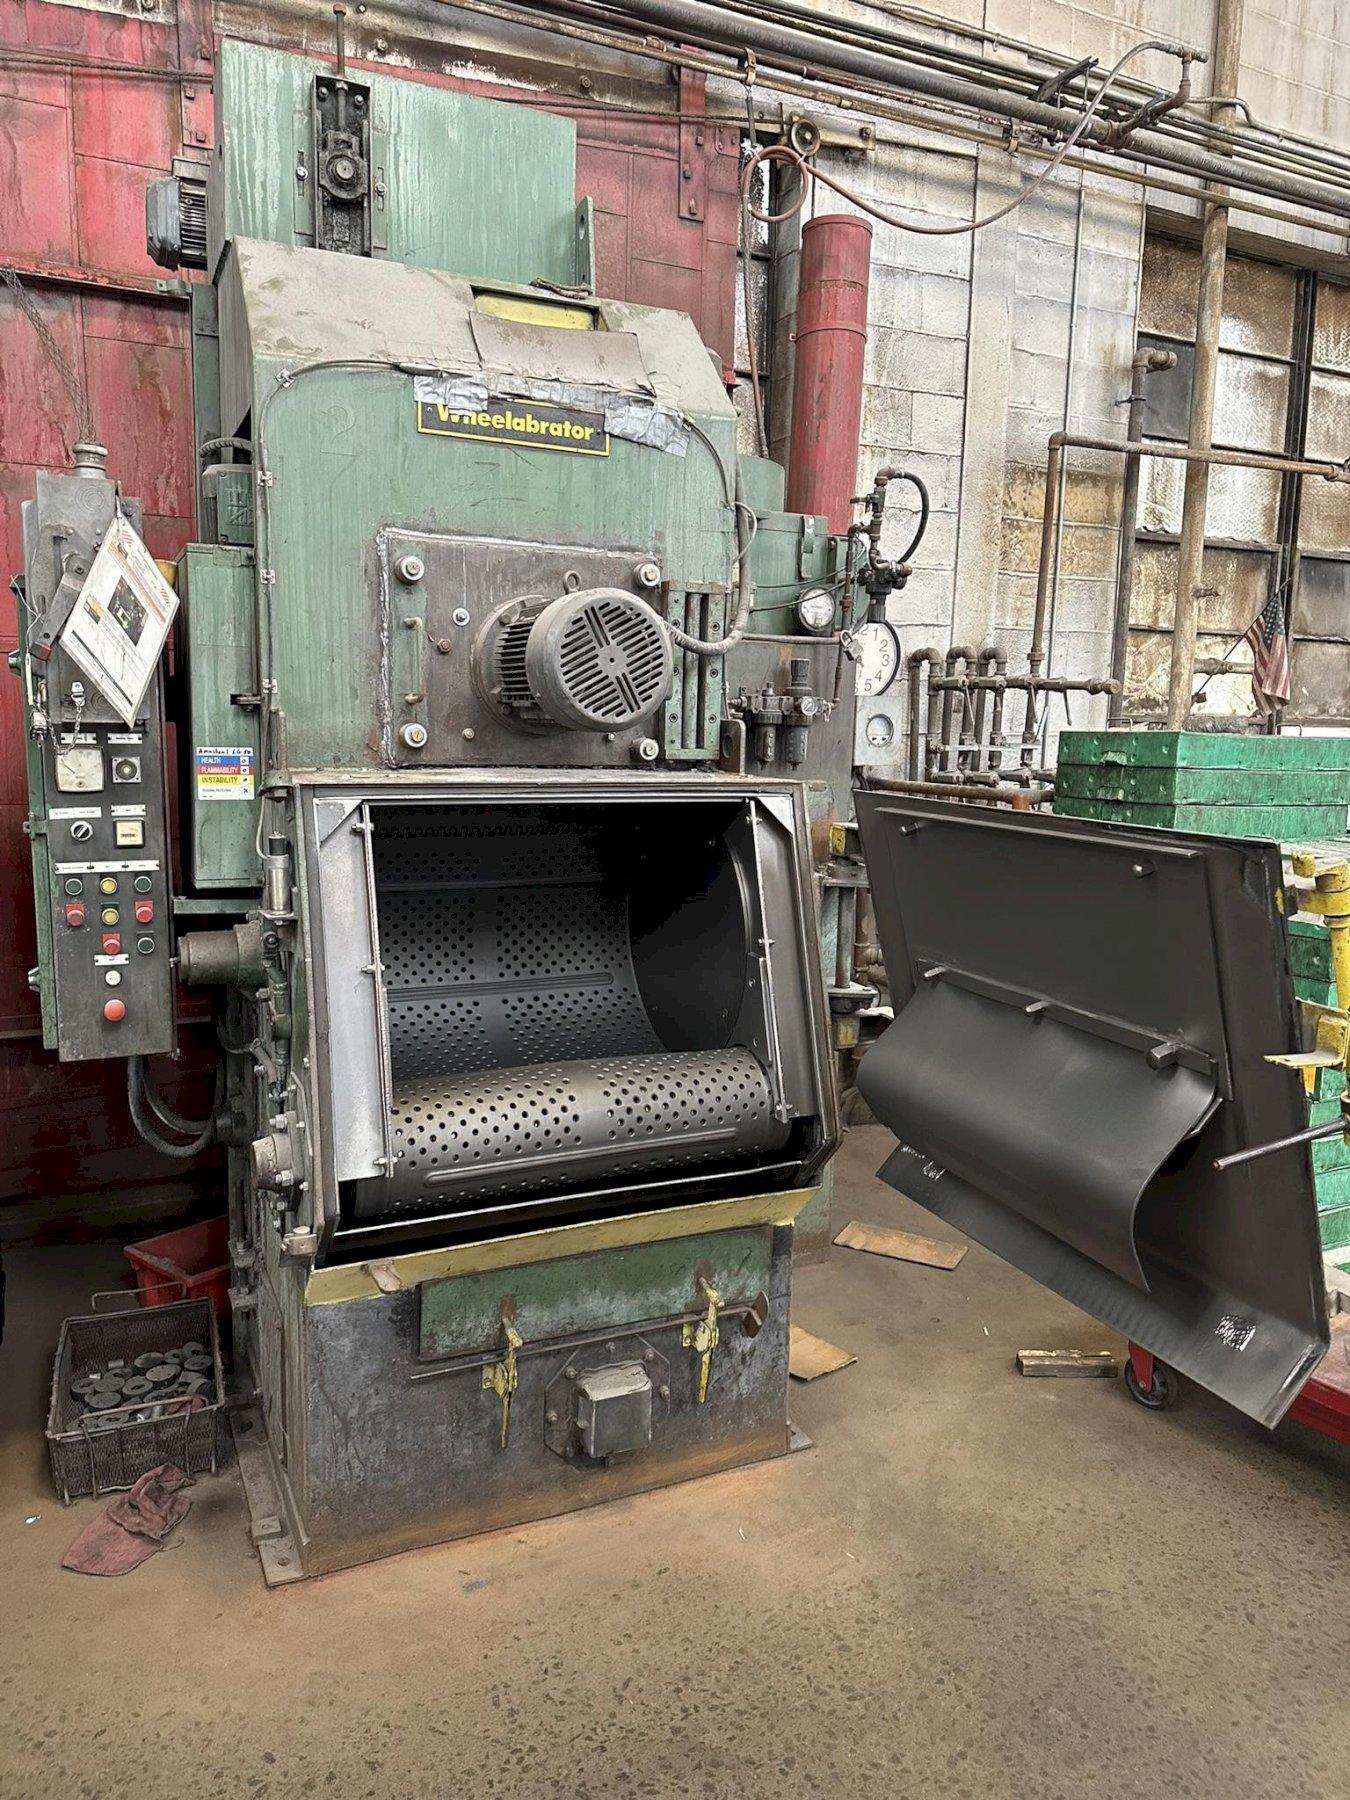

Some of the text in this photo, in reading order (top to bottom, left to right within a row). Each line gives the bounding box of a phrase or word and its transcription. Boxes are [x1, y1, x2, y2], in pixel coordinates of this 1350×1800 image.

[873, 627, 879, 641] 1
[879, 639, 889, 653] 2
[881, 653, 890, 667] 3
[874, 669, 883, 683] 4
[864, 678, 873, 692] 5
[201, 766, 238, 774] FLAMMABILITY
[202, 776, 238, 784] INSTABILITY
